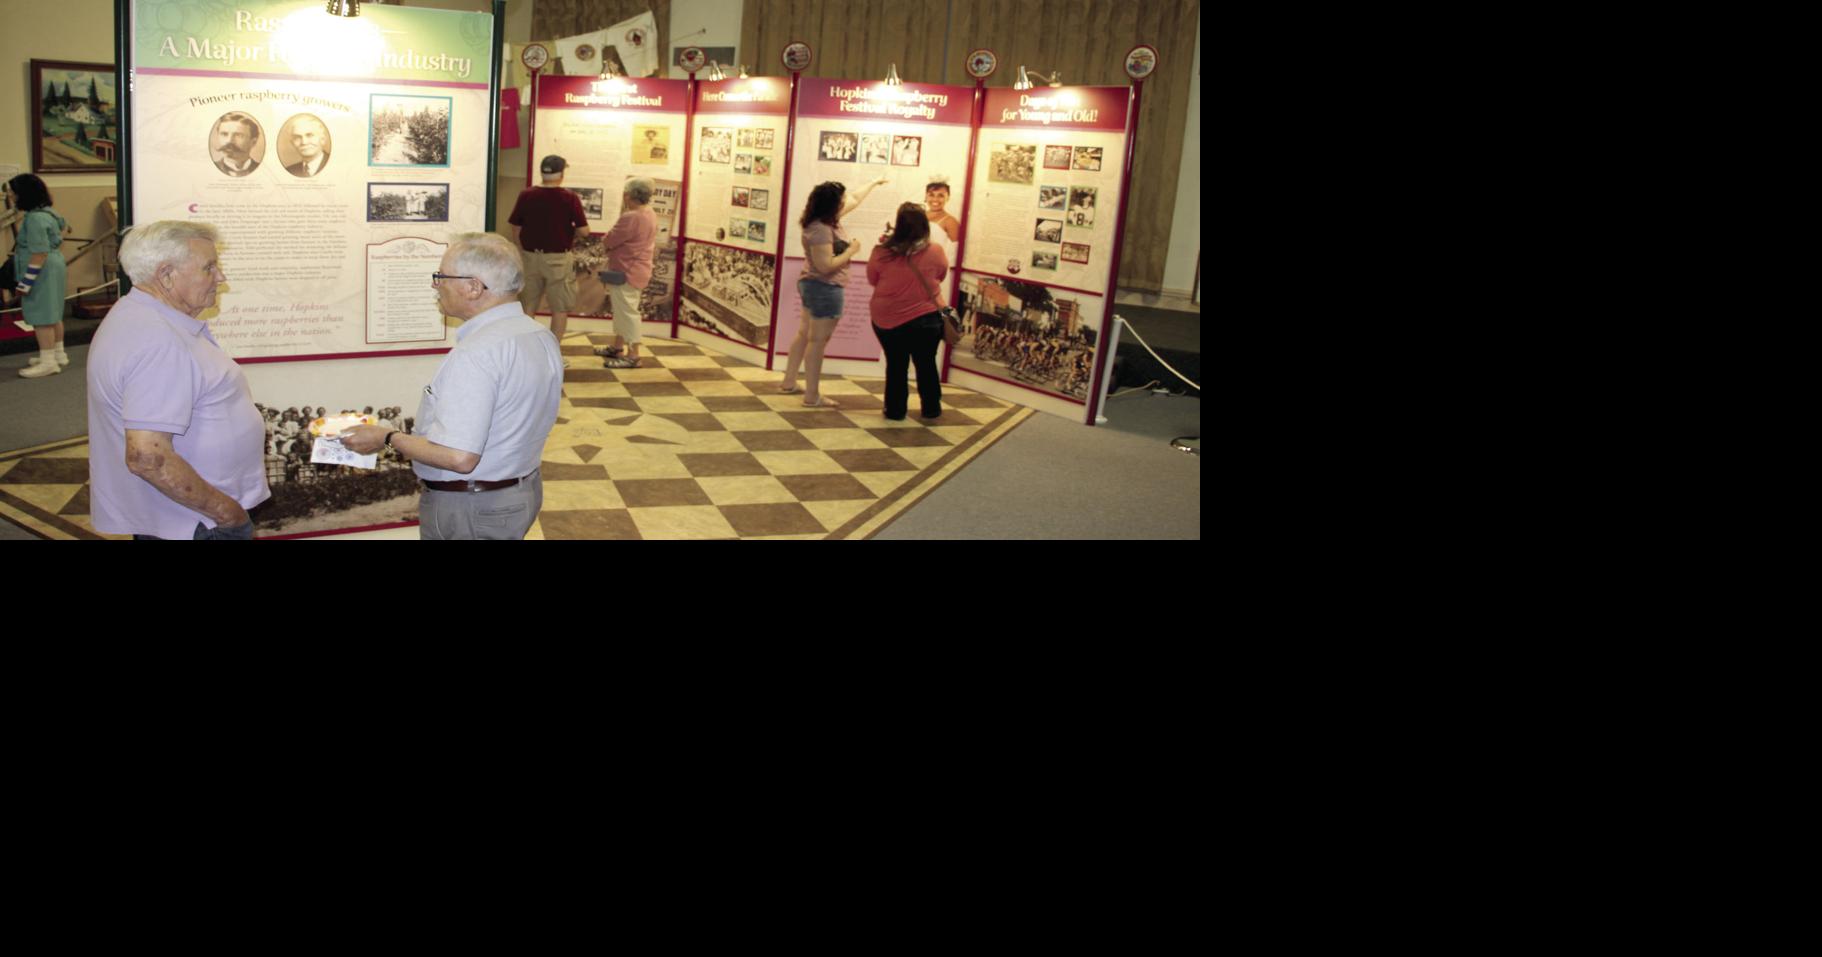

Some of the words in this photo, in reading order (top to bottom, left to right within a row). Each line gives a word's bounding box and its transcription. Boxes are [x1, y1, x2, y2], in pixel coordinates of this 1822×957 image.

[160, 36, 179, 57] A
[187, 37, 262, 65] Major
[376, 46, 472, 78] Industry
[190, 91, 238, 108] Pioneer
[239, 89, 299, 104] raspberry
[302, 96, 351, 113] growers
[565, 93, 620, 107] Raspberry
[621, 95, 662, 106] Festival
[840, 100, 887, 116] Festival
[888, 103, 936, 120] Royalty
[1000, 108, 1018, 123] for
[1018, 109, 1051, 125] Young
[1051, 110, 1073, 122] and
[1073, 109, 1098, 123] Old!
[290, 303, 330, 315] Hopkins
[244, 318, 268, 326] more
[270, 315, 320, 327] raspberries
[322, 314, 345, 323] than
[251, 329, 267, 338] else
[283, 327, 299, 336] the
